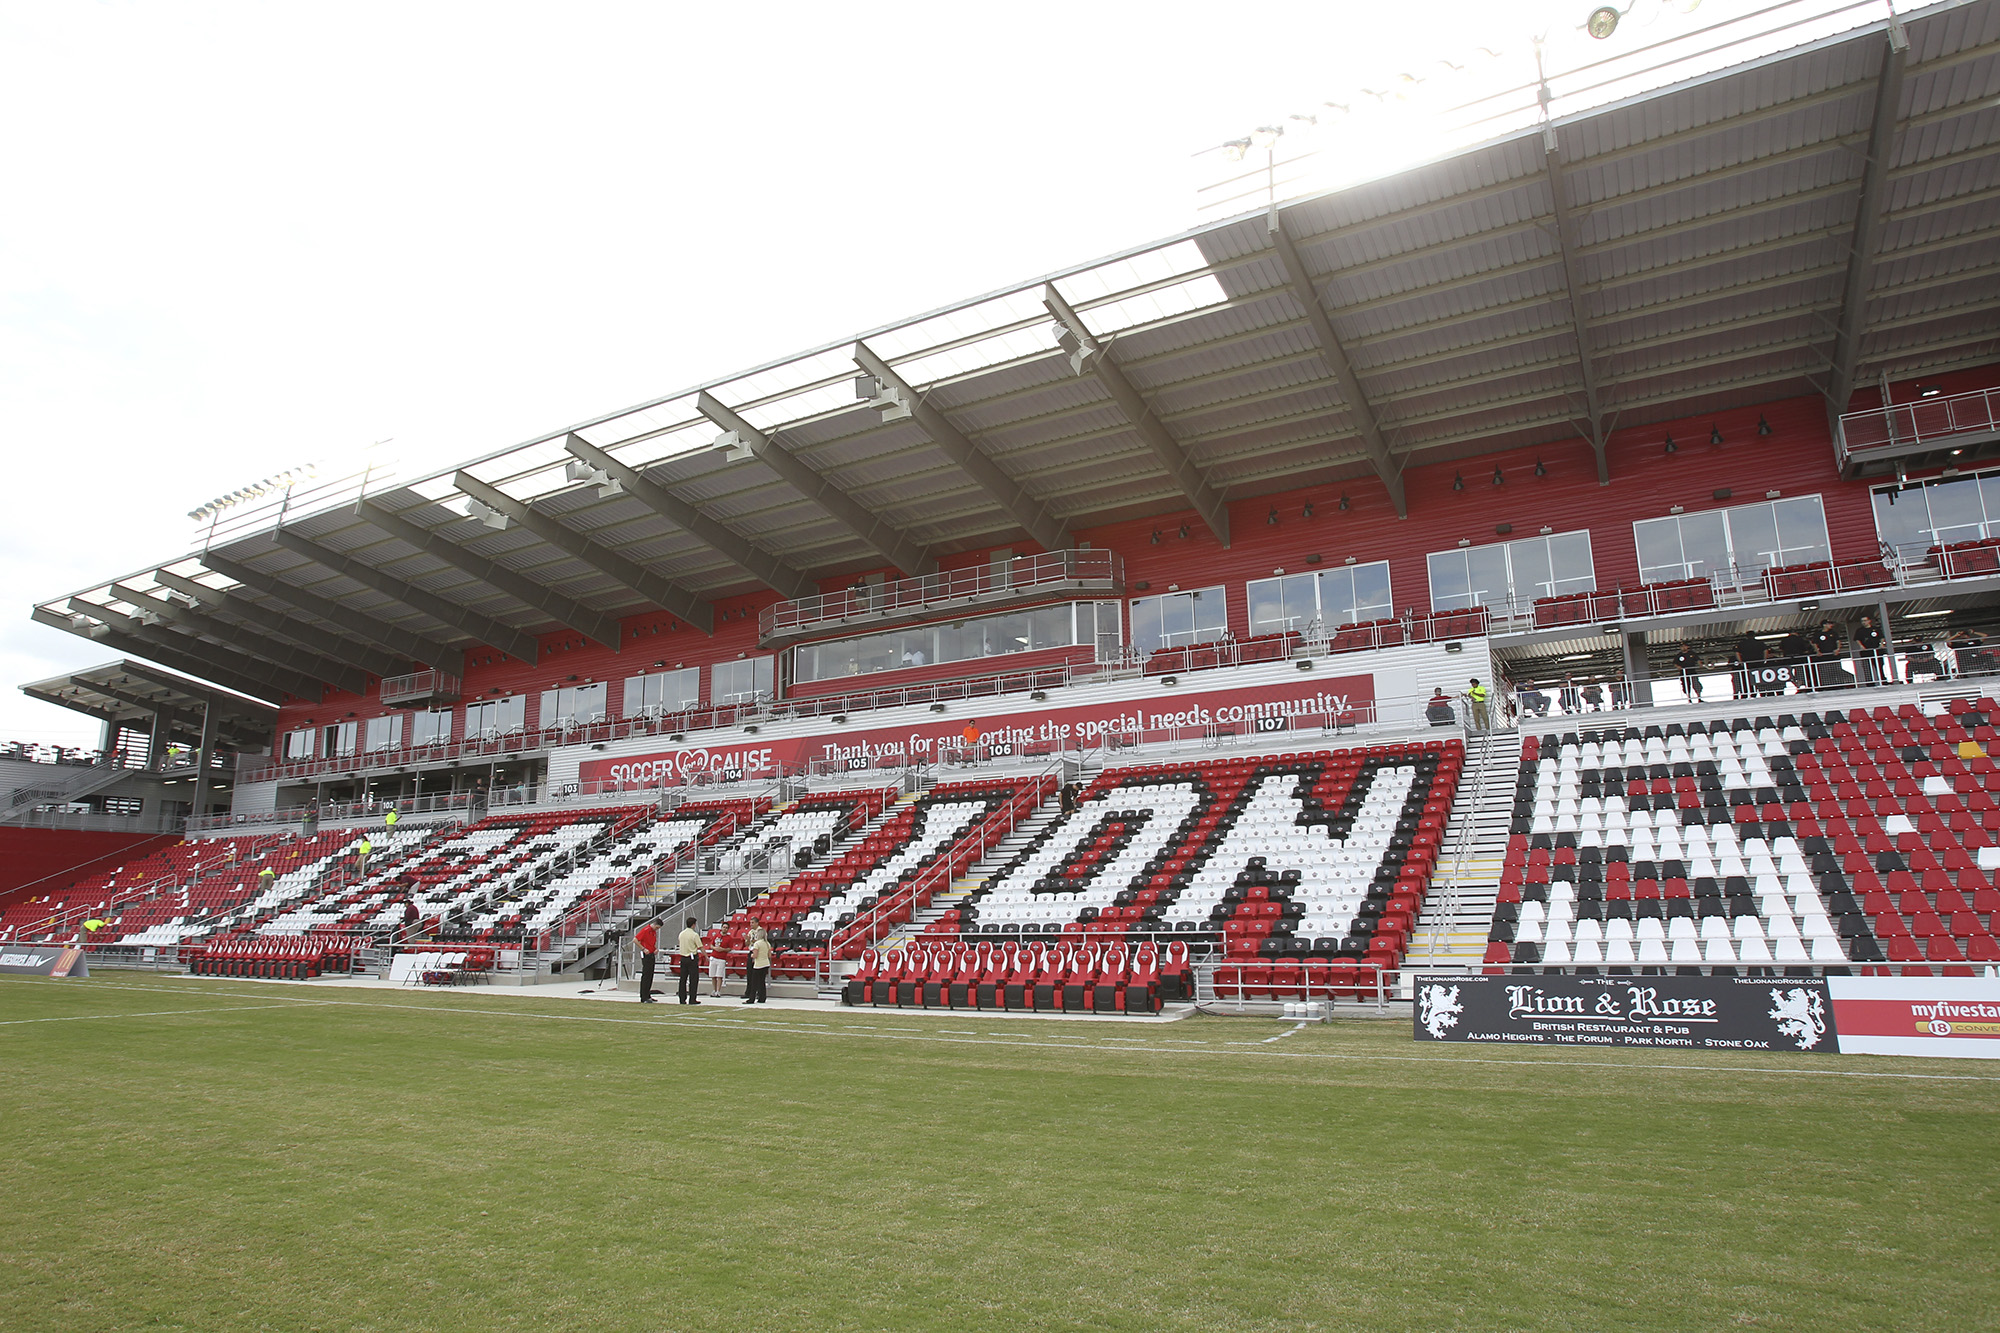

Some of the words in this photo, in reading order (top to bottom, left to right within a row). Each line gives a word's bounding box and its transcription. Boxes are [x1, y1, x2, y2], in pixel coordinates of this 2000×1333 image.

[1751, 667, 1790, 684] 108
[822, 739, 871, 761] Thank
[874, 741, 904, 762] you
[909, 733, 934, 756] for
[937, 725, 1035, 753] suporting
[1039, 719, 1071, 740] the
[1075, 710, 1144, 740] special
[1150, 703, 1210, 731] needs
[1215, 692, 1353, 724] community.
[1257, 718, 1284, 731] 107
[989, 744, 1012, 756] 106
[610, 758, 674, 785] SOCCER
[710, 748, 773, 774] CAUSE
[848, 758, 867, 769] 105
[724, 769, 743, 780] 104
[563, 784, 578, 794] 103
[383, 801, 394, 809] 102
[1595, 978, 1615, 986] THE
[1505, 985, 1585, 1020] Lion
[1595, 993, 1621, 1015] &
[1627, 986, 1718, 1023] Rose
[1911, 1001, 2000, 1020] myfivesta
[1532, 1022, 1575, 1032] BRITISH
[1576, 1023, 1651, 1034] RESTAURANT
[1653, 1025, 1663, 1034] &
[1665, 1026, 1690, 1035] PUB
[1930, 1022, 1949, 1033] 18
[1467, 1032, 1500, 1041] ALAMO
[1502, 1032, 1544, 1042] HEIGHTS
[1554, 1033, 1576, 1042] THE
[1576, 1034, 1613, 1044] FORUM
[1624, 1036, 1653, 1045] PARK
[1655, 1037, 1693, 1047] NORTH
[1704, 1038, 1743, 1048] STONE
[1744, 1039, 1770, 1049] OAK
